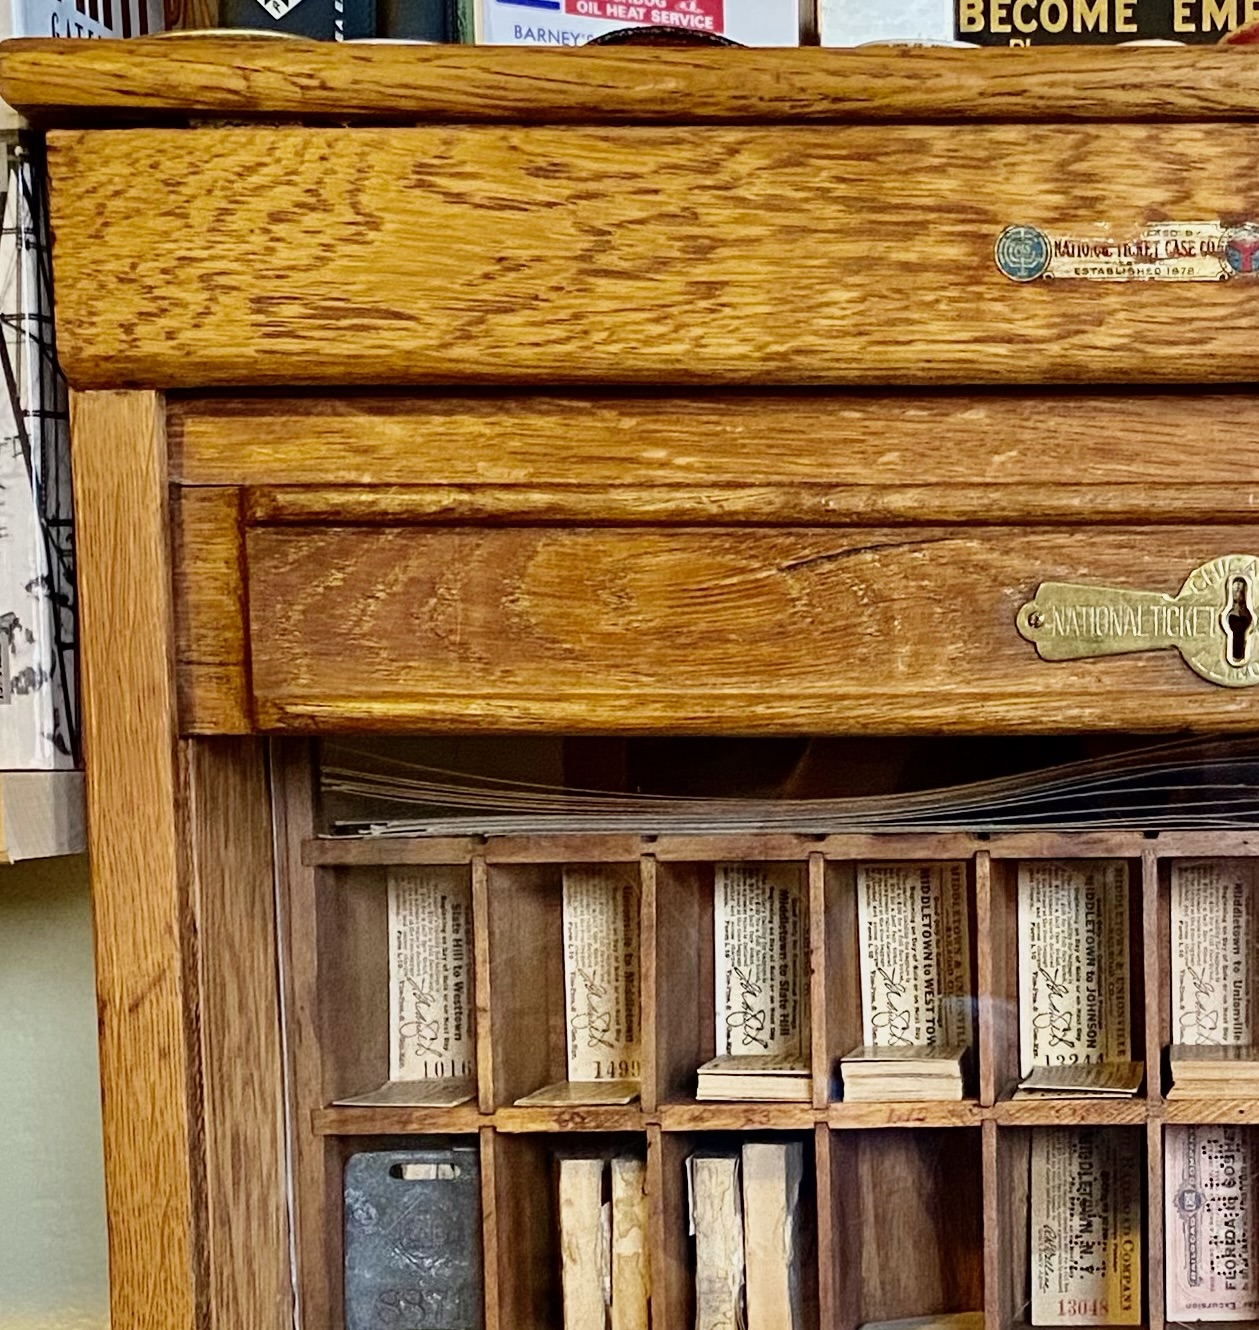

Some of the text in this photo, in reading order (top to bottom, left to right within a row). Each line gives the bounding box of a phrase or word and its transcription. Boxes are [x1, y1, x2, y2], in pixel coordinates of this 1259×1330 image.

[576, 2, 602, 15] OIL
[606, 6, 644, 21] HEAT
[651, 11, 714, 29] SERVICE
[959, 0, 1139, 33] BECOME
[1166, 240, 1196, 258] CASE
[1051, 605, 1145, 637] NATIONAL
[1151, 604, 1218, 639] TICKET
[453, 938, 463, 1041] Hill to Westtown
[780, 964, 789, 1036] to Hill
[923, 964, 933, 1012] to WEST
[1085, 971, 1097, 1049] to JOHNSON
[1233, 961, 1243, 1041] to Unionville
